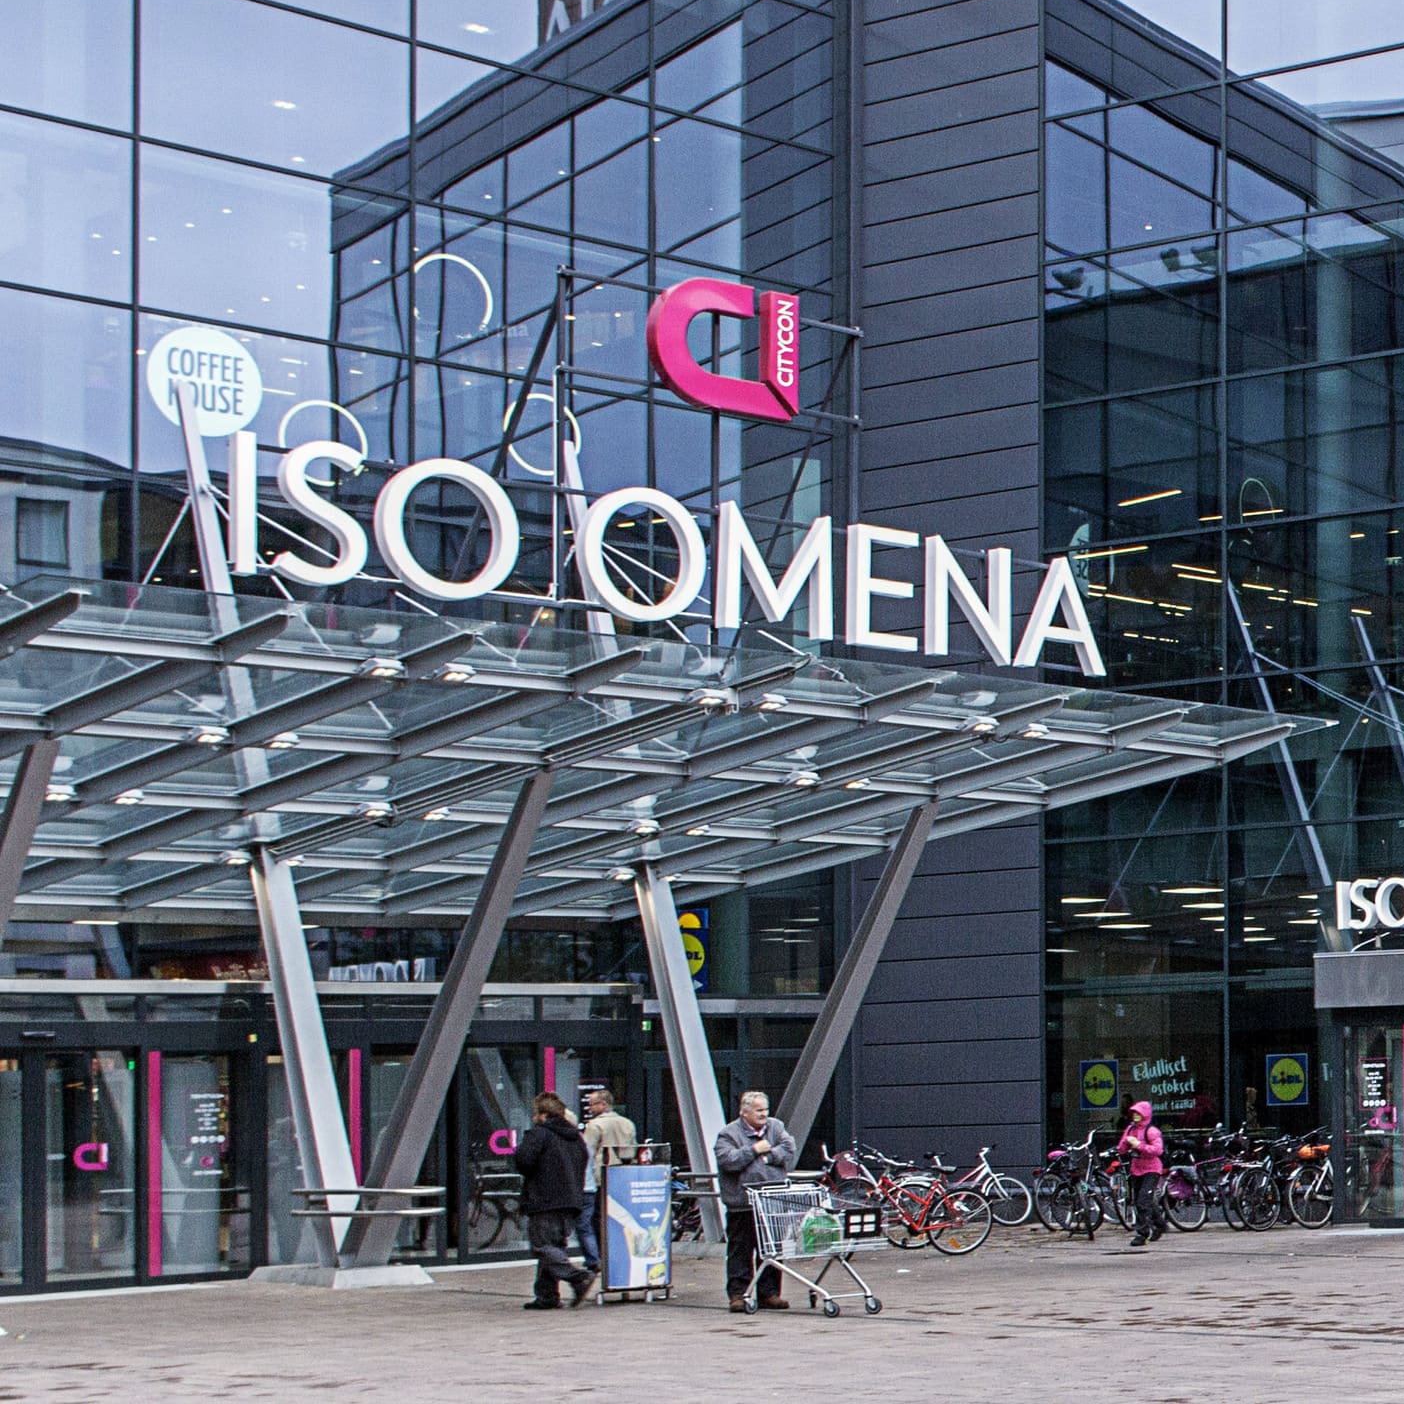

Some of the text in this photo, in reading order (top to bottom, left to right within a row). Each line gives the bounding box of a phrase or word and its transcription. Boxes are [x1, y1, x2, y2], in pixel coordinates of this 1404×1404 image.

[167, 347, 244, 384] COFFEE
[777, 299, 794, 387] CITYCON
[228, 431, 1106, 677] ISO OMENA
